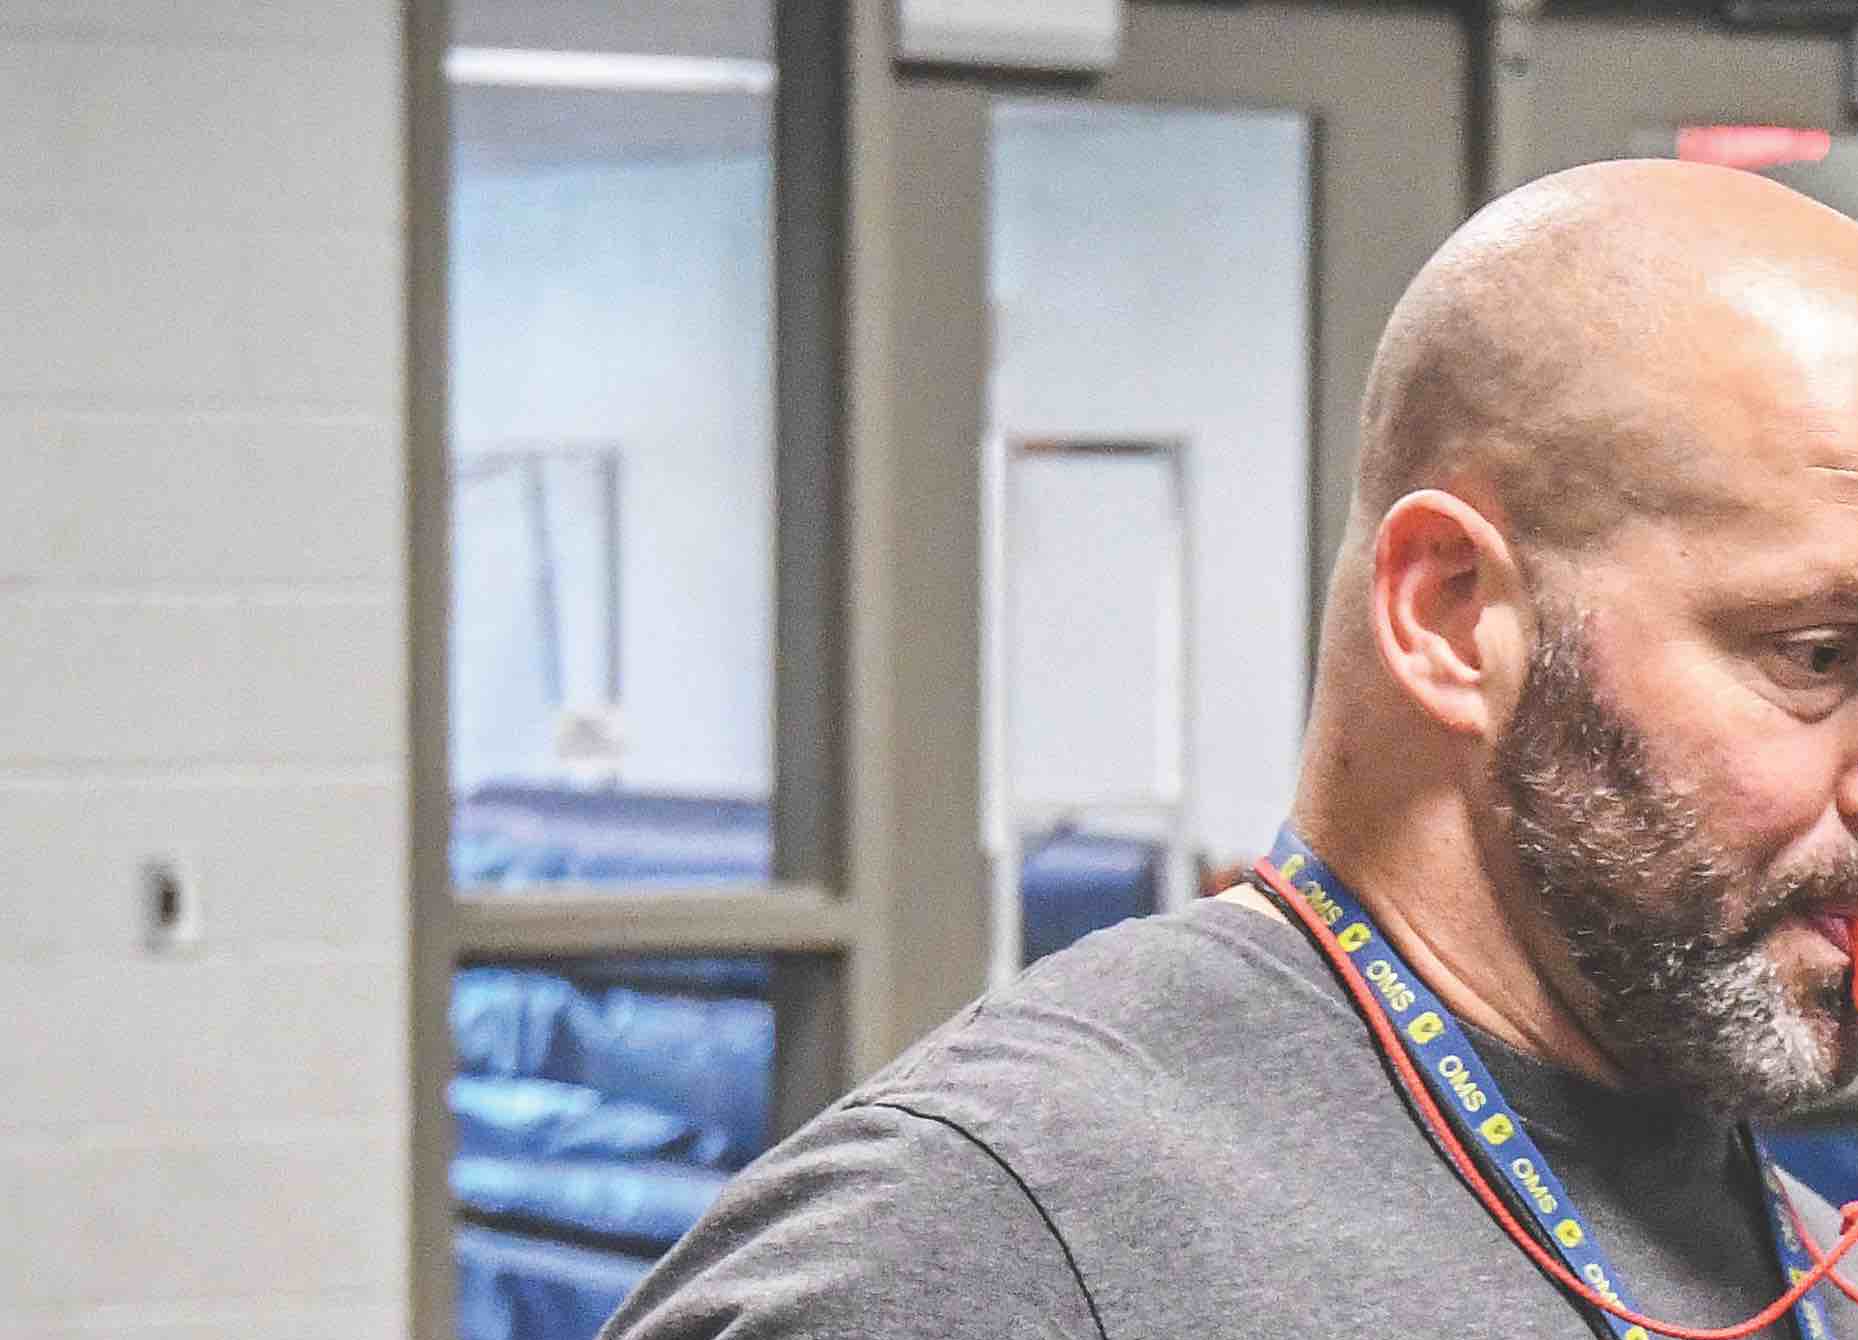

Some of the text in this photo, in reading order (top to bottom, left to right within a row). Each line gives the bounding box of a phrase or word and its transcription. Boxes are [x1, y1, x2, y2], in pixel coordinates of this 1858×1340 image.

[1366, 959, 1416, 1012] OMS
[1439, 1055, 1487, 1112] OMS
[1511, 1157, 1558, 1214] OMS
[1583, 1263, 1627, 1310] OM
